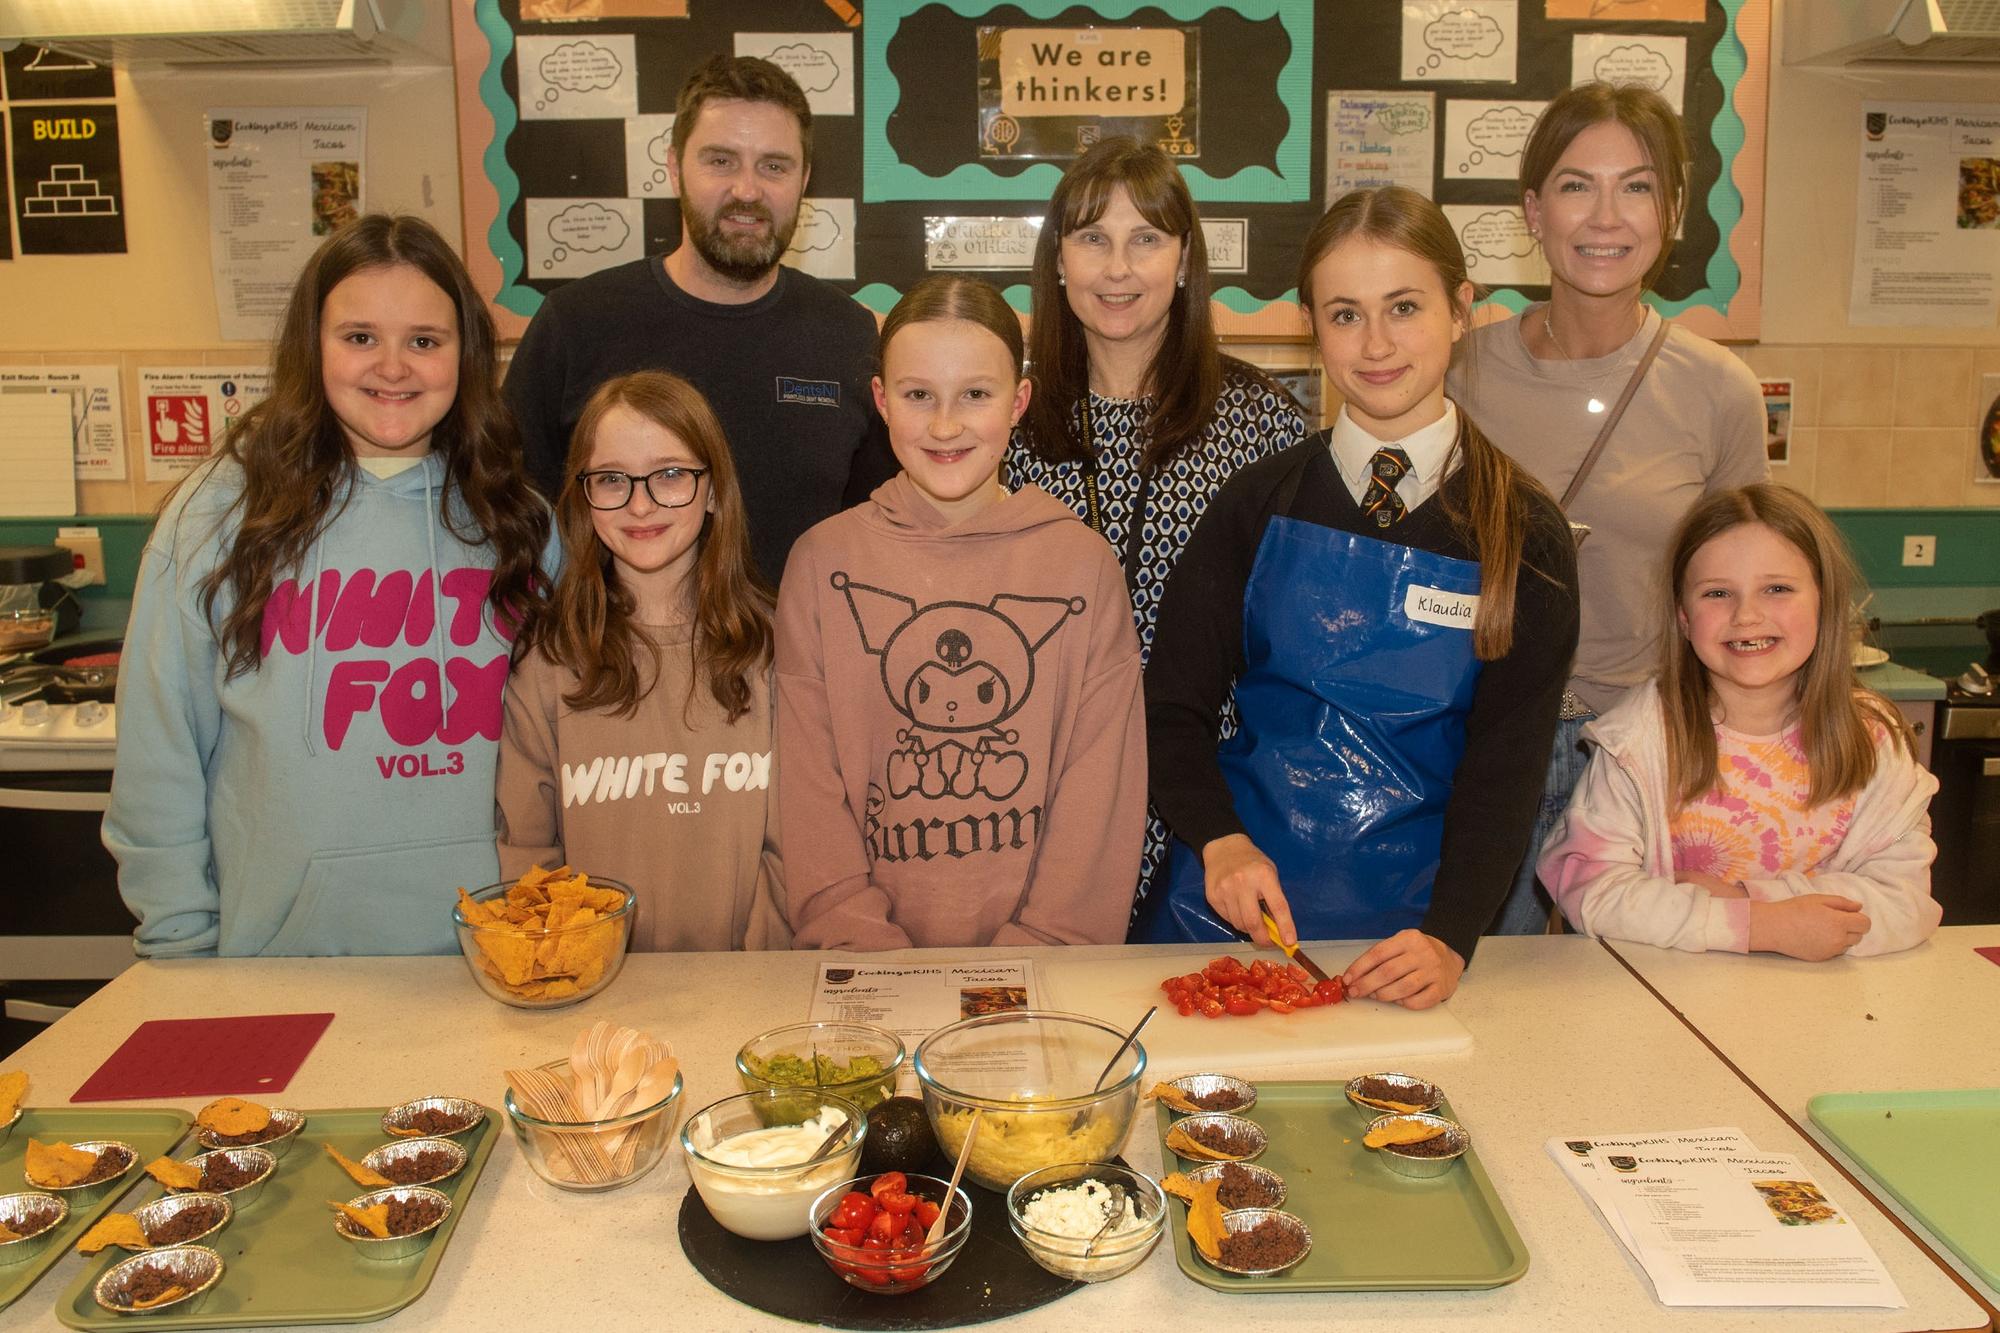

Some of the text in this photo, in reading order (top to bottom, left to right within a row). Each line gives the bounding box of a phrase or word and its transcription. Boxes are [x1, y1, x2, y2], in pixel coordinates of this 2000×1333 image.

[1031, 43, 1151, 66] We are
[1016, 76, 1166, 102] thinkers!
[33, 118, 96, 140] BUILD
[304, 121, 356, 131] Mexican
[313, 138, 345, 149] Tacos
[1962, 135, 1993, 145] Tacos
[964, 240, 1026, 255] OTHERS
[154, 442, 209, 453] Fire alarm
[1086, 474, 1095, 488] JHS
[1915, 545, 1923, 557] 2
[1417, 595, 1471, 619] Klaudia
[323, 654, 510, 751] FOX
[375, 751, 465, 779] VOL.3
[561, 750, 772, 809] WHITE FOX
[667, 801, 701, 814] VOL.3
[865, 804, 1042, 863] Kurom
[857, 968, 942, 977] Cooking@KJHS
[951, 966, 1019, 975] Mexican
[1594, 1138, 1669, 1148] Cooking@KJHS
[1677, 1136, 1739, 1144] Mexican
[1638, 1156, 1718, 1165] Cooking@KJHS
[1726, 1157, 1791, 1165] Mexican
